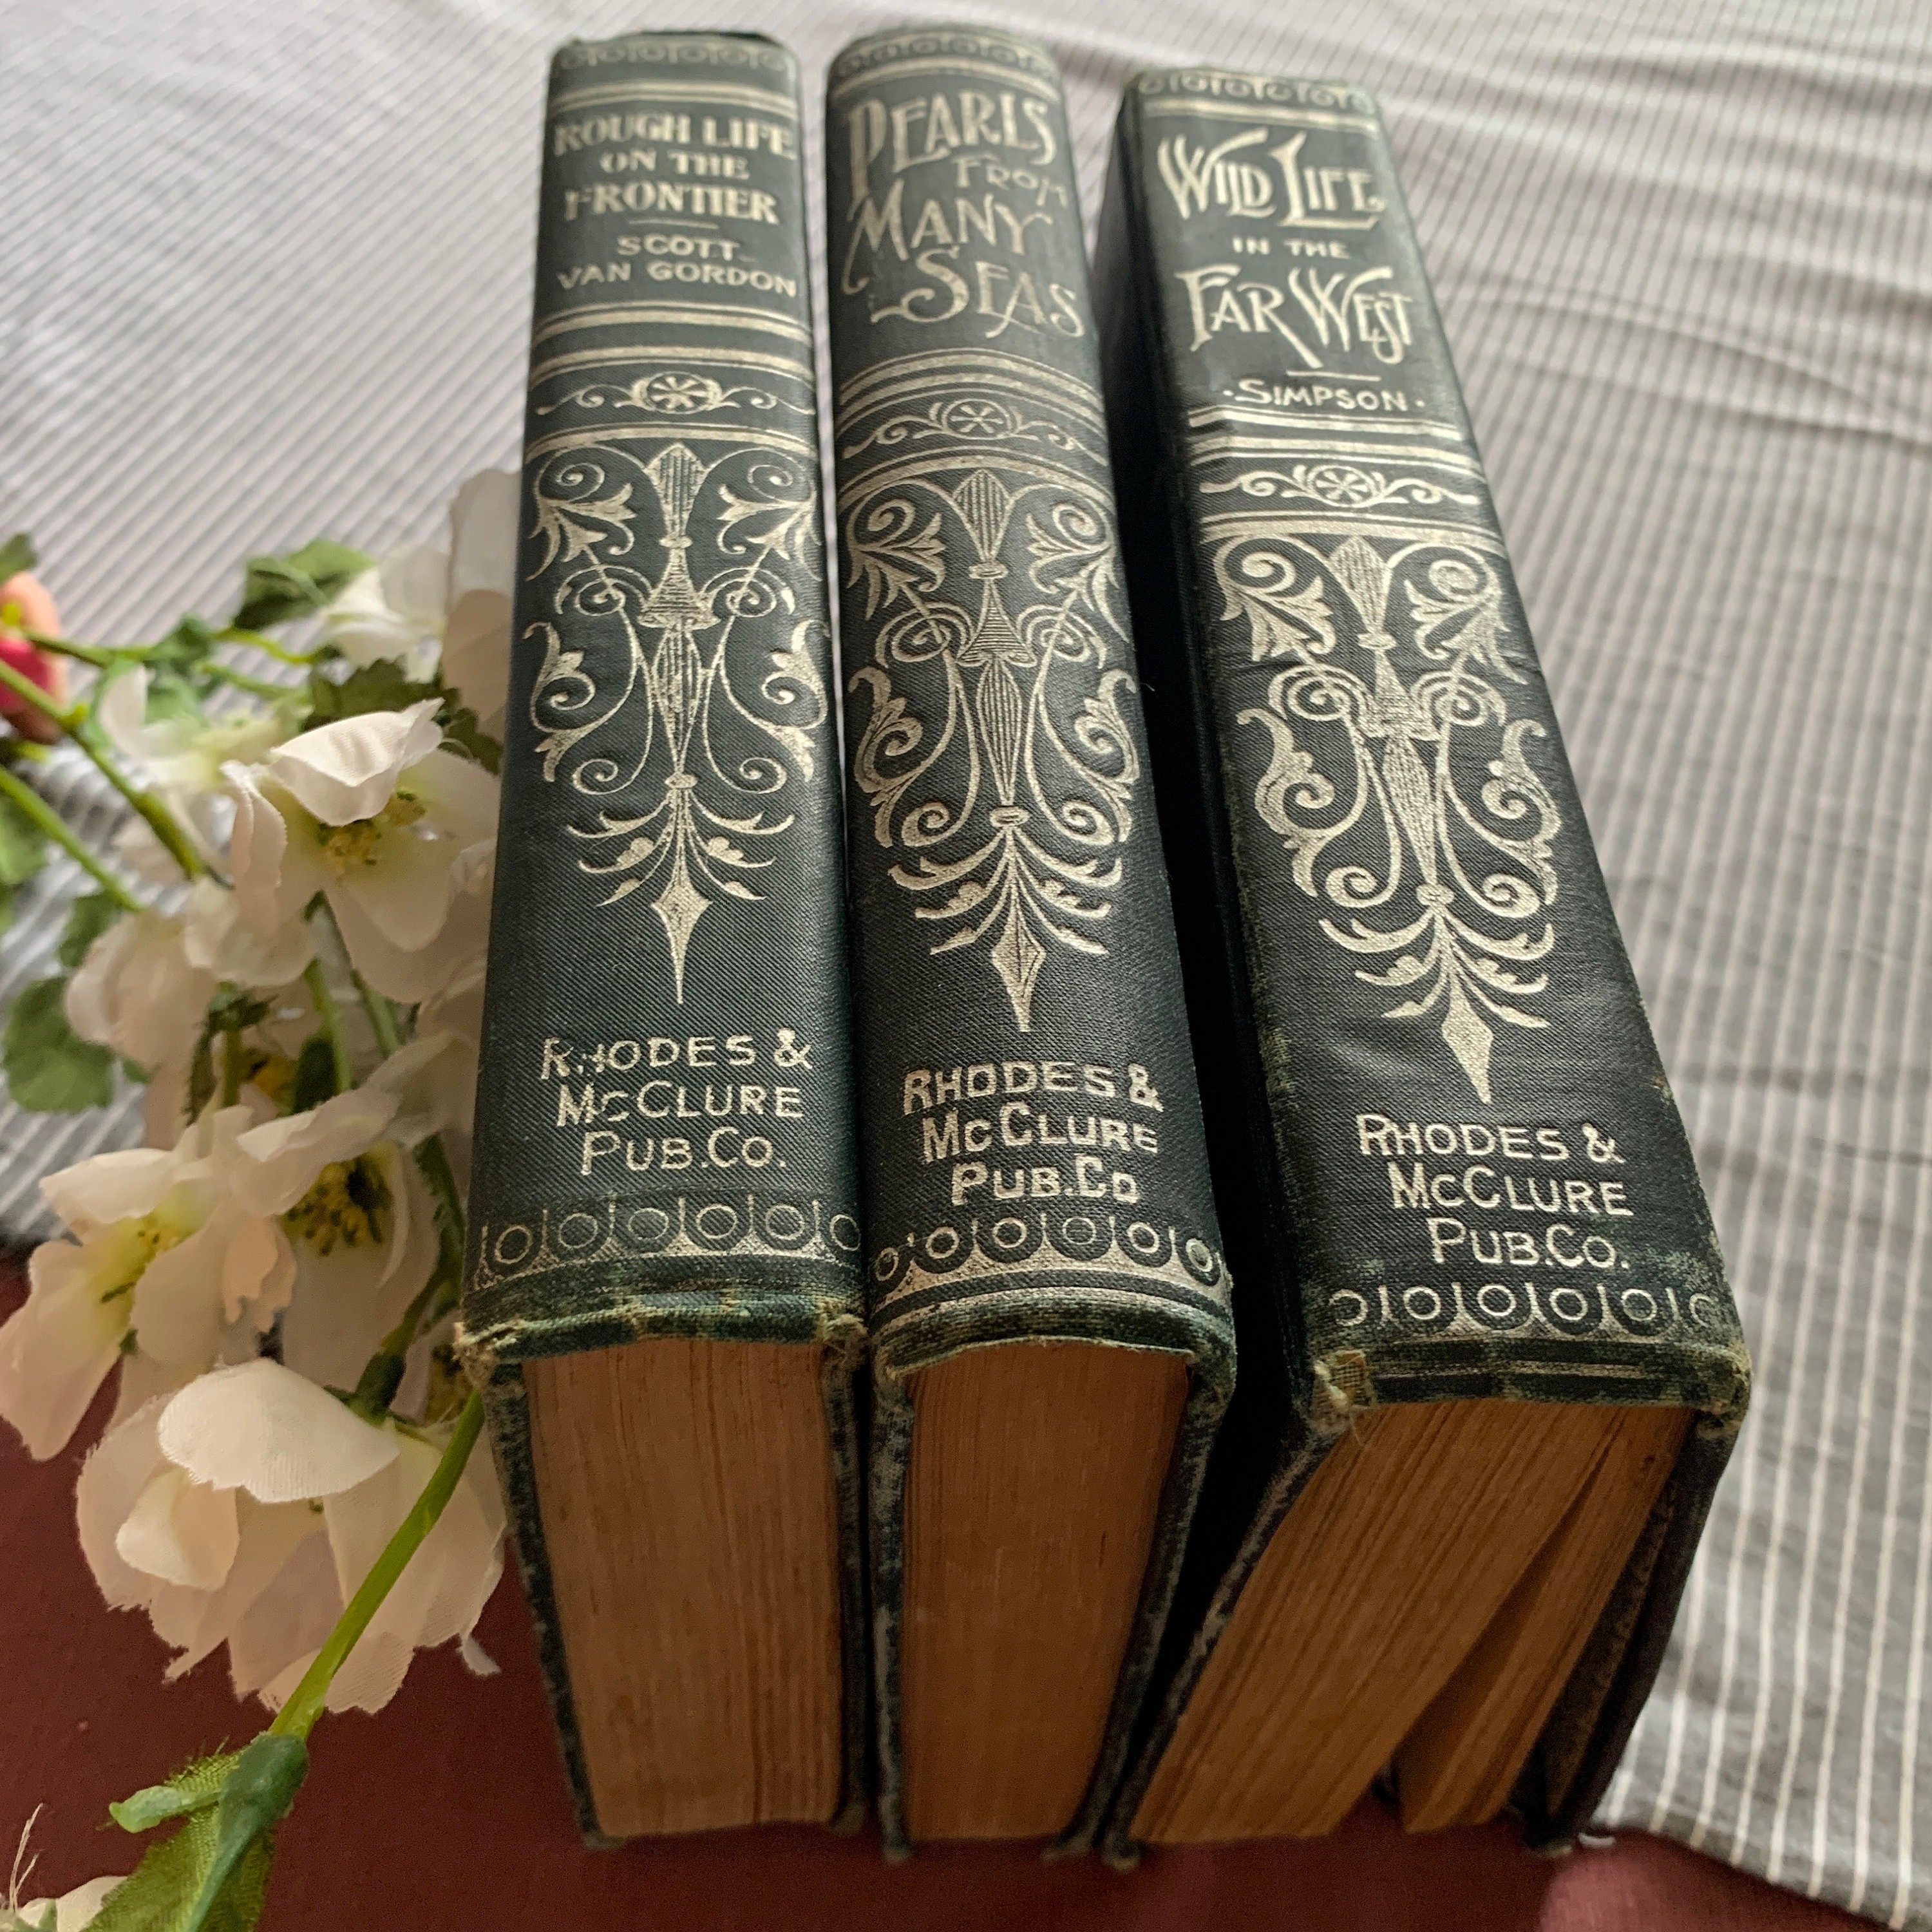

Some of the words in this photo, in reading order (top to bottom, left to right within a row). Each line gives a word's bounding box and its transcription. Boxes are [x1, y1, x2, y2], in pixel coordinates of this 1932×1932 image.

[554, 111, 691, 156] ROUGH
[702, 117, 797, 160] LIFE
[848, 90, 1056, 222] PEARLS
[600, 148, 656, 173] ON
[667, 149, 750, 180] THE
[951, 152, 1069, 209] FROM
[1158, 128, 1276, 220] WILD
[1268, 131, 1386, 231] LIFE
[564, 180, 779, 225] FRONTIER
[616, 234, 741, 261] SCOTT
[842, 179, 1054, 295] MANY
[1232, 236, 1271, 255] IN
[1284, 238, 1351, 259] THE
[557, 262, 632, 289] VAN
[647, 260, 797, 298] GORDON
[870, 245, 1085, 339] SEAS
[1174, 264, 1323, 369] FAR
[1288, 266, 1412, 365] WEST
[773, 1027, 813, 1070] &
[904, 1061, 1116, 1115] RHODES
[1128, 1063, 1164, 1112] &
[1356, 1113, 1570, 1160] RHODES
[1582, 1122, 1626, 1164] &
